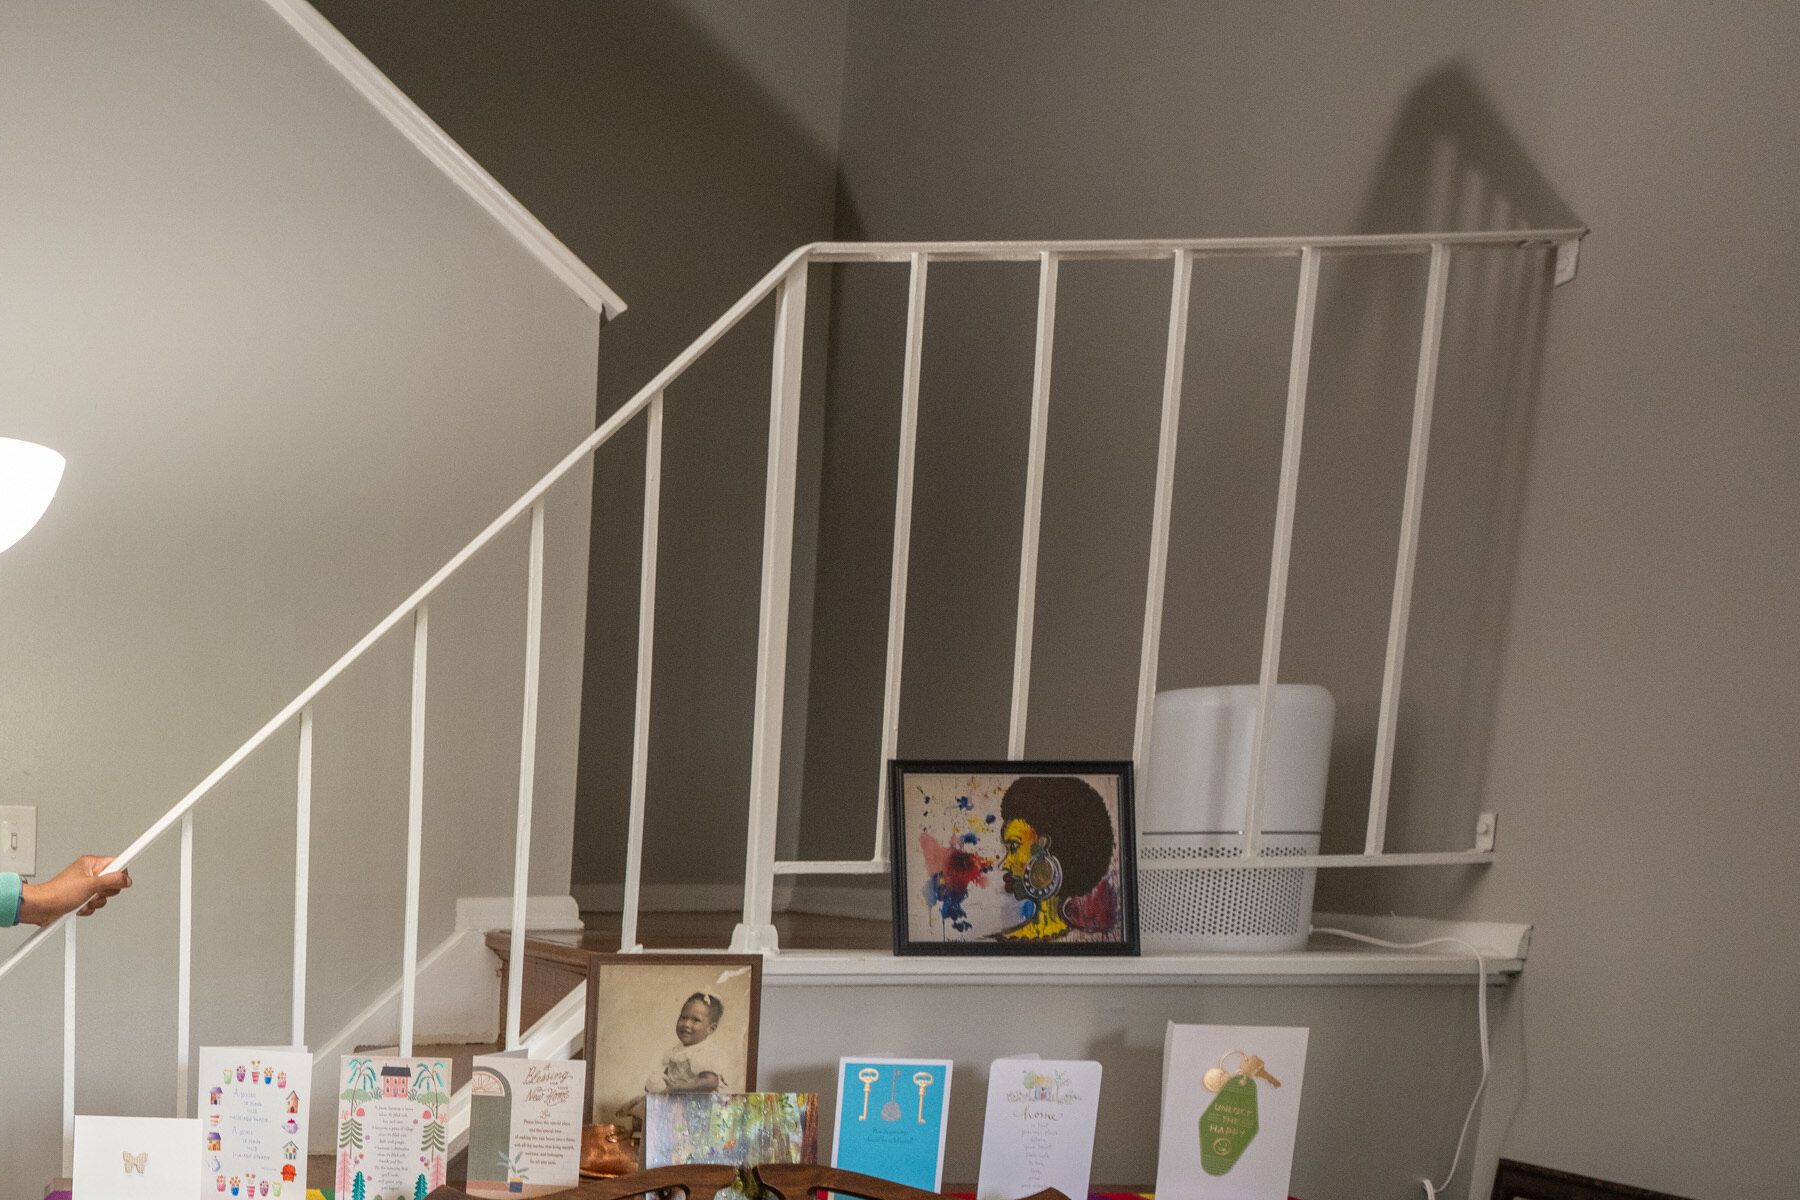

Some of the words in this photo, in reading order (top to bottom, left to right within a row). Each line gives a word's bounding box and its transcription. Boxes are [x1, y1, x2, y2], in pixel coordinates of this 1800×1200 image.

[523, 1065, 574, 1085] Blessing
[525, 1086, 545, 1103] New
[544, 1087, 570, 1107] Home
[1013, 1104, 1064, 1122] home
[1214, 1103, 1253, 1117] UNLOCK
[1222, 1115, 1238, 1125] THE
[1209, 1123, 1248, 1138] HAPPY
